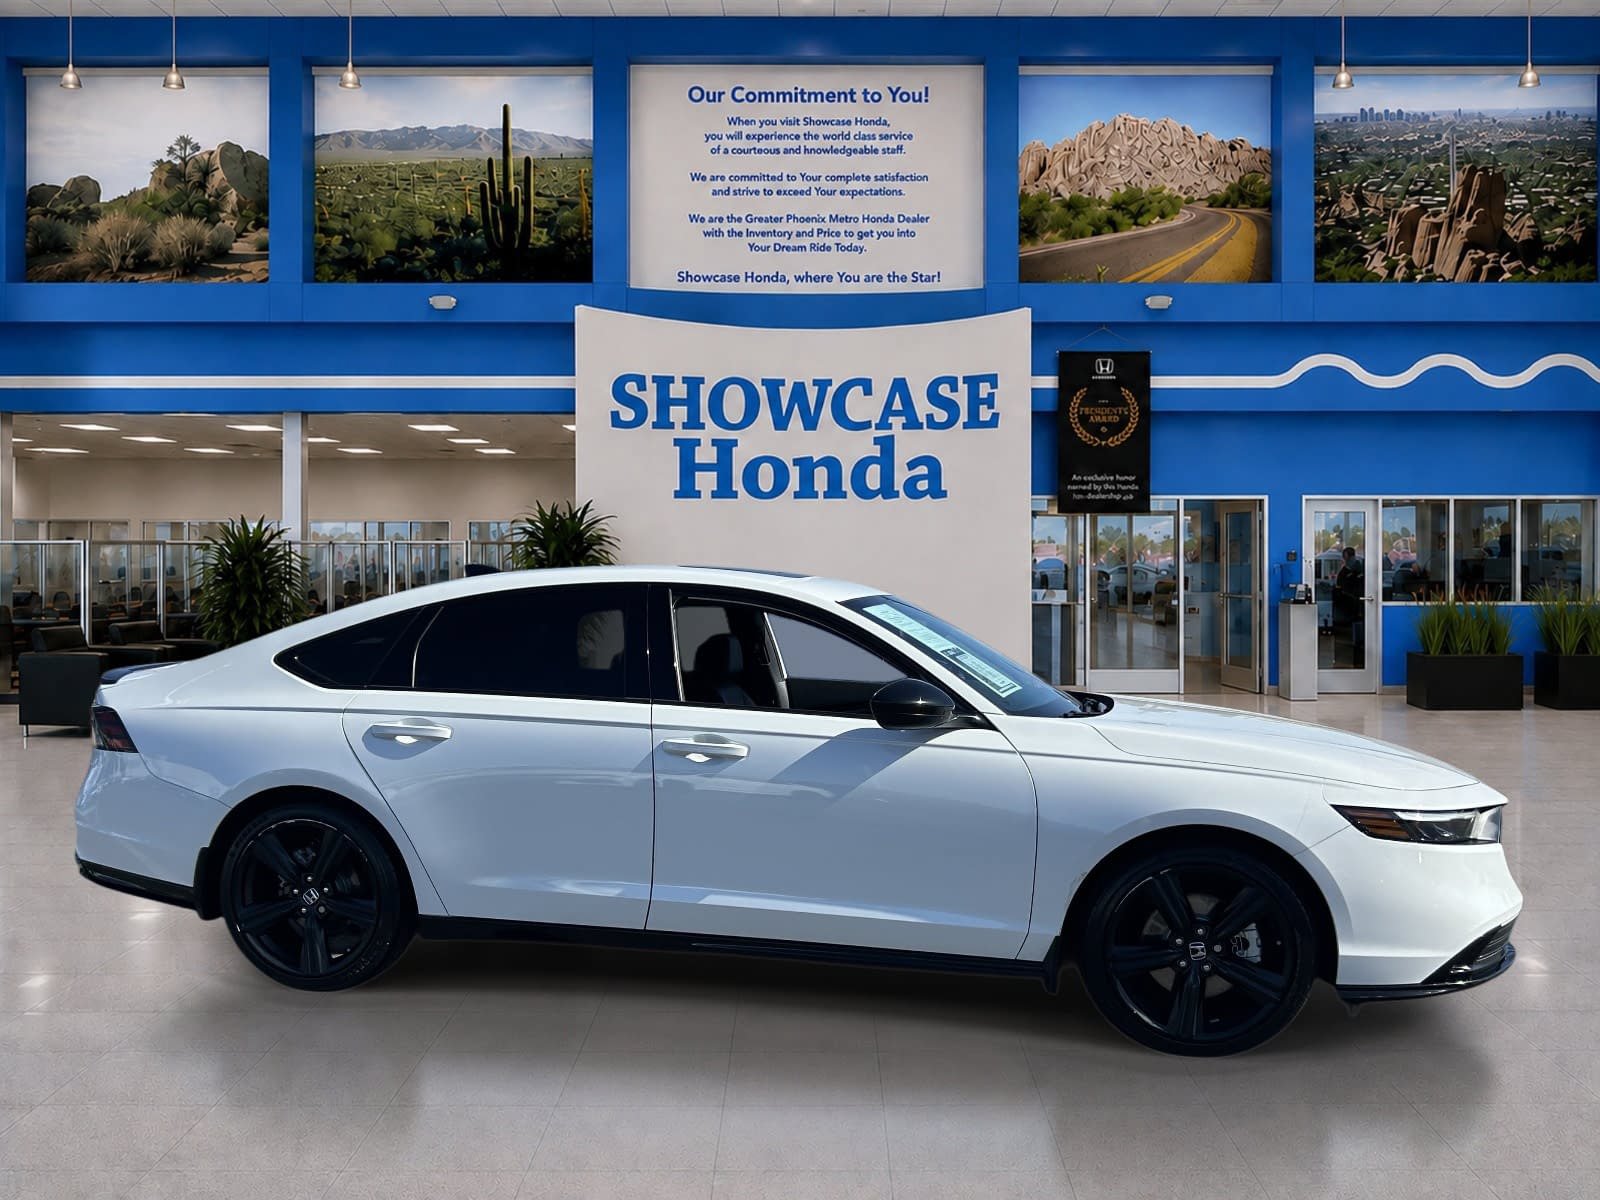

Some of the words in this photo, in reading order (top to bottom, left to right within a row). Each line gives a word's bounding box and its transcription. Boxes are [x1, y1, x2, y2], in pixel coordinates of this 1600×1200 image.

[688, 86, 725, 103] Our
[731, 86, 856, 103] Commitment
[862, 88, 882, 103] to
[887, 86, 929, 103] You!
[726, 116, 756, 127] When
[758, 118, 777, 129] you
[779, 116, 800, 127] visit
[802, 115, 852, 127] Showcase
[854, 116, 890, 128] Honda,
[704, 133, 723, 144] you
[725, 130, 742, 141] will
[745, 130, 800, 144] experience
[802, 130, 819, 141] the
[821, 130, 850, 141] world
[852, 130, 876, 141] class
[878, 130, 913, 141] service
[709, 144, 721, 155] of
[722, 147, 729, 155] a
[730, 146, 780, 156] courteous
[782, 144, 801, 155] and
[881, 144, 905, 155] staff.
[689, 172, 707, 183] We
[709, 174, 725, 182] are
[728, 171, 783, 183] committed
[786, 173, 797, 183] to
[799, 172, 822, 183] Your
[824, 172, 871, 185] complete
[873, 171, 928, 183] satisfaction
[711, 185, 730, 197] and
[732, 186, 760, 197] strive
[762, 187, 773, 197] to
[775, 186, 811, 197] exceed
[813, 186, 837, 197] Your
[839, 186, 905, 200] expectations.
[688, 213, 705, 224] We
[707, 215, 724, 224] are
[725, 213, 742, 224] the
[744, 213, 784, 224] Greater
[785, 213, 826, 224] Phoenix
[828, 213, 859, 224] Metro
[861, 213, 894, 224] Honda
[897, 213, 930, 224] Dealer
[702, 227, 724, 238] with
[726, 227, 743, 238] the
[745, 227, 793, 241] Inventory
[795, 227, 814, 239] and
[816, 227, 841, 238] Price
[843, 229, 854, 238] to
[856, 229, 874, 241] get
[876, 230, 894, 241] you
[896, 227, 916, 238] into
[747, 242, 771, 253] Your
[773, 242, 806, 253] Dream
[809, 242, 832, 253] Ride
[833, 242, 866, 255] Today.
[676, 270, 740, 284] Showcase
[744, 270, 789, 286] Honda,
[793, 270, 833, 284] where
[836, 271, 860, 284] You
[863, 274, 883, 284] are
[886, 270, 907, 284] the
[911, 271, 940, 284] Star!
[609, 372, 1001, 432] SHOWCASE
[672, 434, 948, 500] Honda
